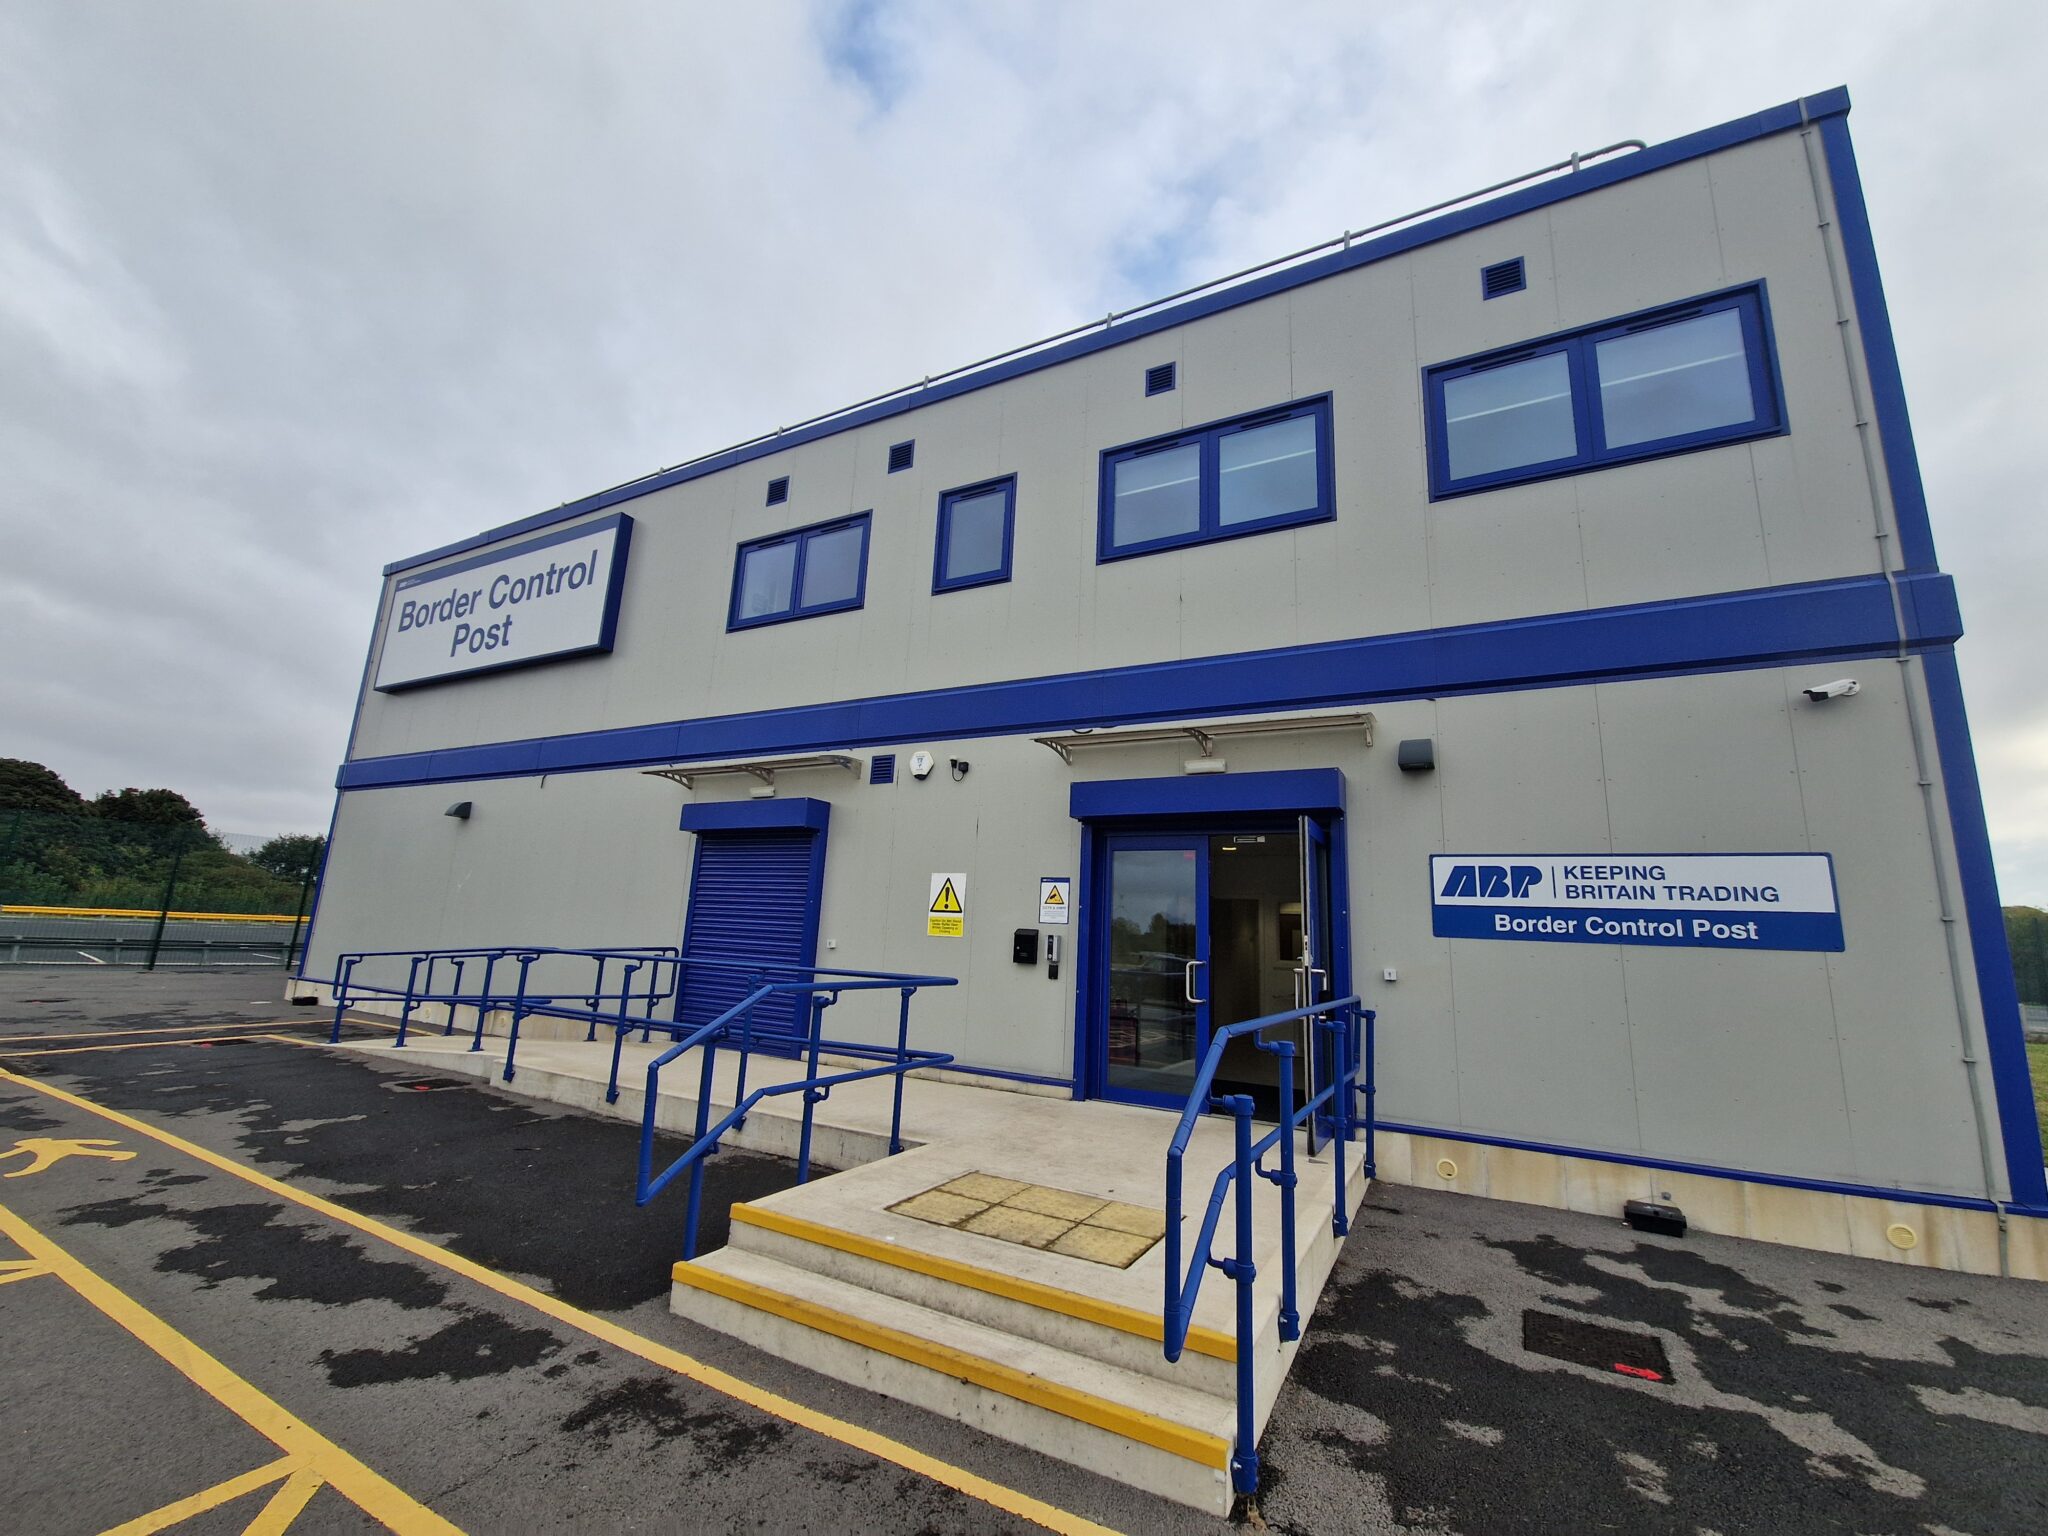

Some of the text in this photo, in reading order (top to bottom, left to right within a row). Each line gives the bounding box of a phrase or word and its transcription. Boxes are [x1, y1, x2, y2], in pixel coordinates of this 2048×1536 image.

[398, 549, 598, 633] Border Control
[450, 614, 513, 657] Post
[1440, 865, 1543, 898] ABP
[1563, 865, 1666, 881] KEEPING
[1565, 885, 1780, 903] BRITAIN TRADING
[1494, 914, 1759, 940] Border Control Post
